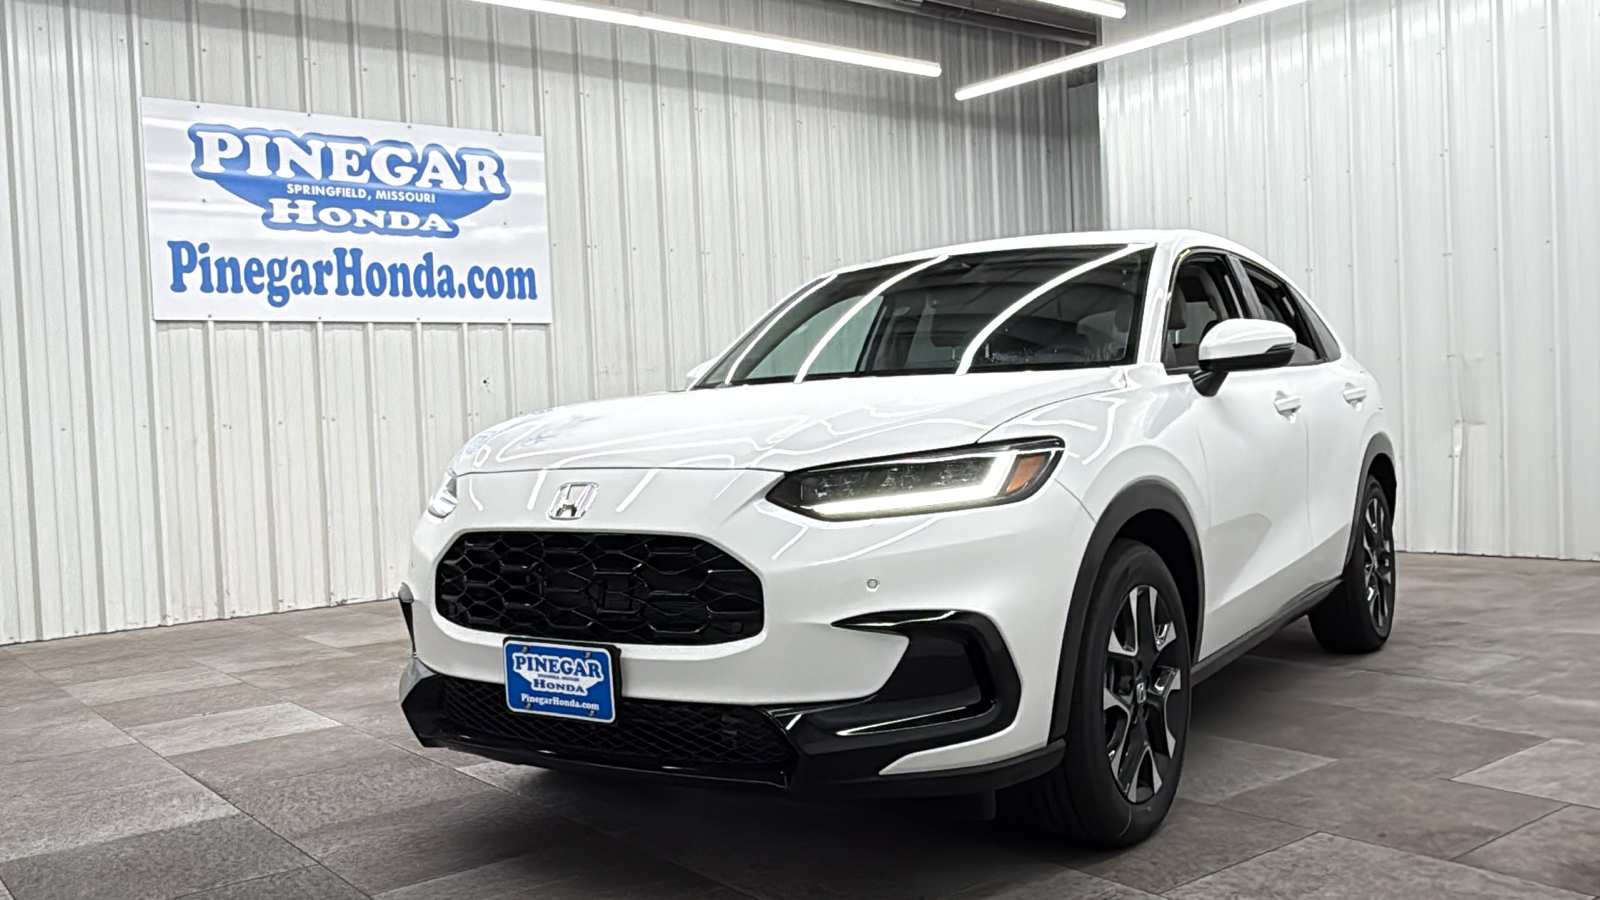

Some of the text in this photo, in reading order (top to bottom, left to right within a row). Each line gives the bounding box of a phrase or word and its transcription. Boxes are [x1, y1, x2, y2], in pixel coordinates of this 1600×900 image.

[196, 130, 505, 194] PINEGAR
[286, 183, 436, 204] SPRINGFIELD, MISSOURI
[269, 198, 453, 232] HONDA
[166, 240, 538, 307] PinegarHonda.com
[514, 655, 602, 679] PINEGAR
[532, 678, 586, 694] HONDA
[520, 693, 600, 710] PinegarHonda.com
